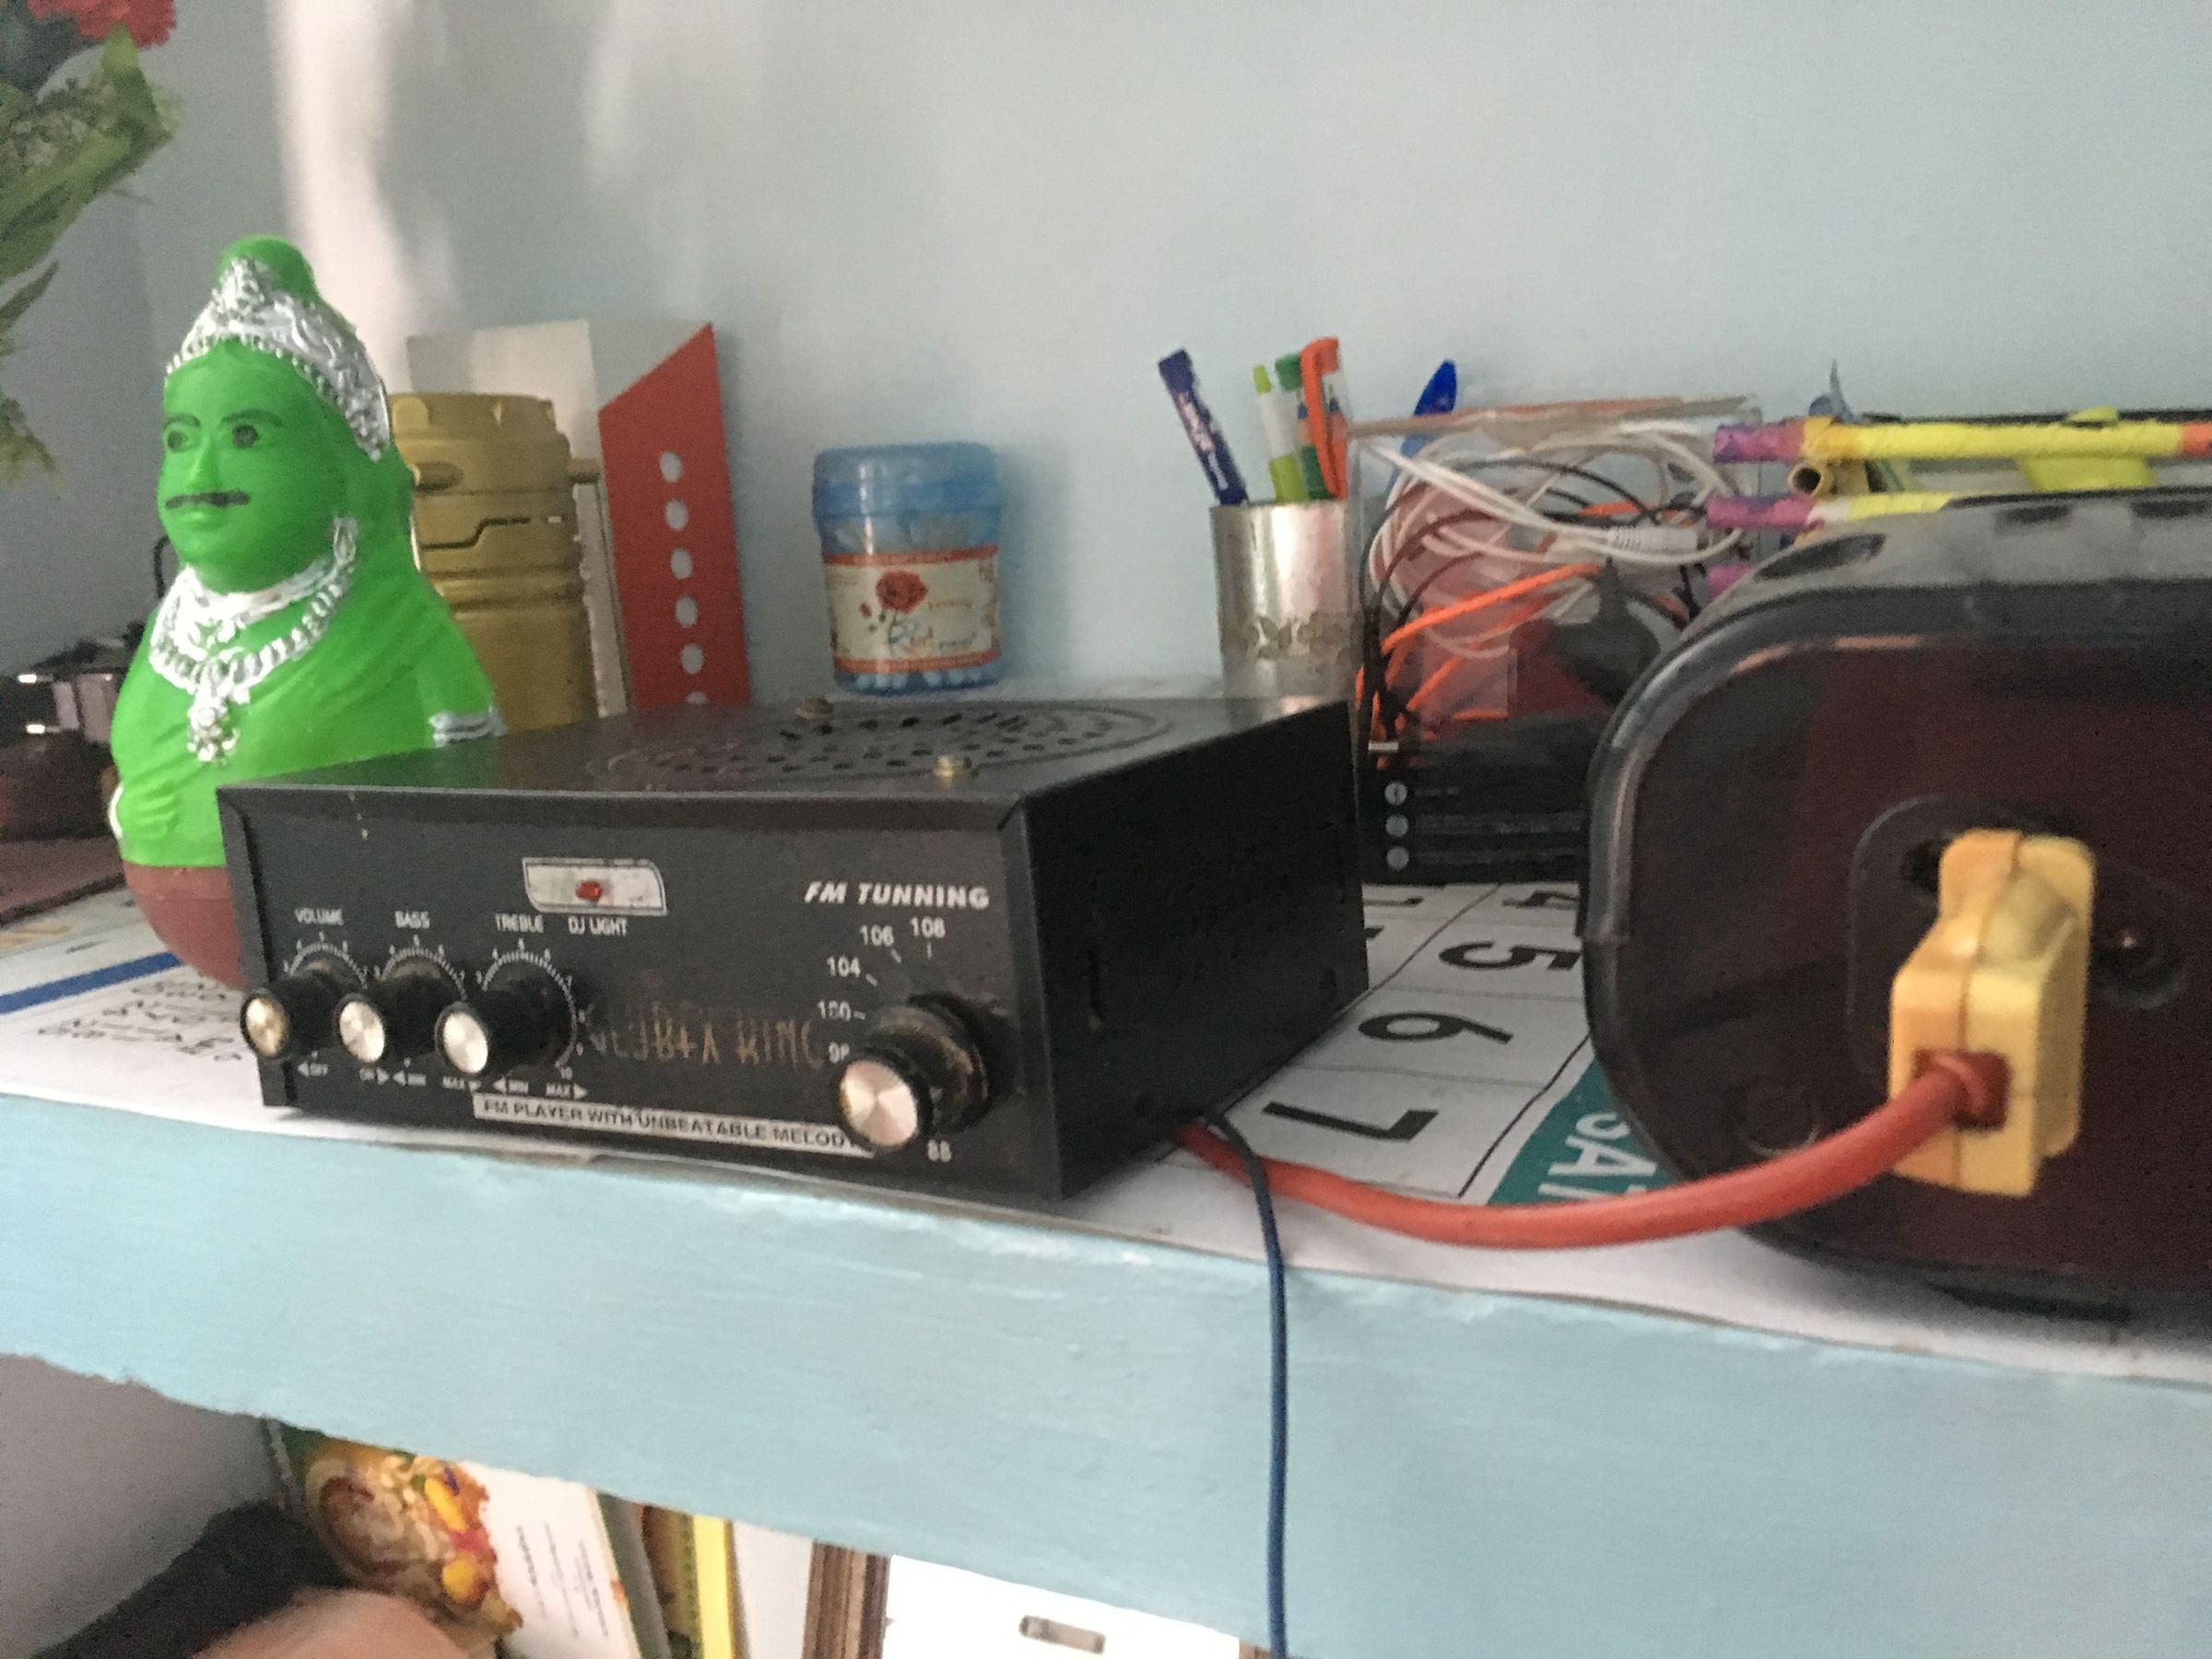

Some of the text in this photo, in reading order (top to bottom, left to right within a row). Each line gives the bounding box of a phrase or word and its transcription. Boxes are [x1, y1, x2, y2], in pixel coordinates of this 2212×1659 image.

[804, 880, 990, 910] FM TUNNING
[295, 907, 345, 926] VOLUME
[394, 910, 430, 929] BASS
[495, 912, 545, 934] TREBLE
[567, 915, 629, 936] DJ LIGHT
[910, 915, 947, 938] 108
[859, 924, 895, 947] 106
[1439, 940, 1583, 970] 5
[826, 955, 862, 979] 104
[1358, 1011, 1514, 1045] 6
[484, 1099, 858, 1150] FM PLAYER WITH UNBEATABLE MELOD
[1261, 1101, 1440, 1143] 7
[927, 1139, 952, 1162] 88
